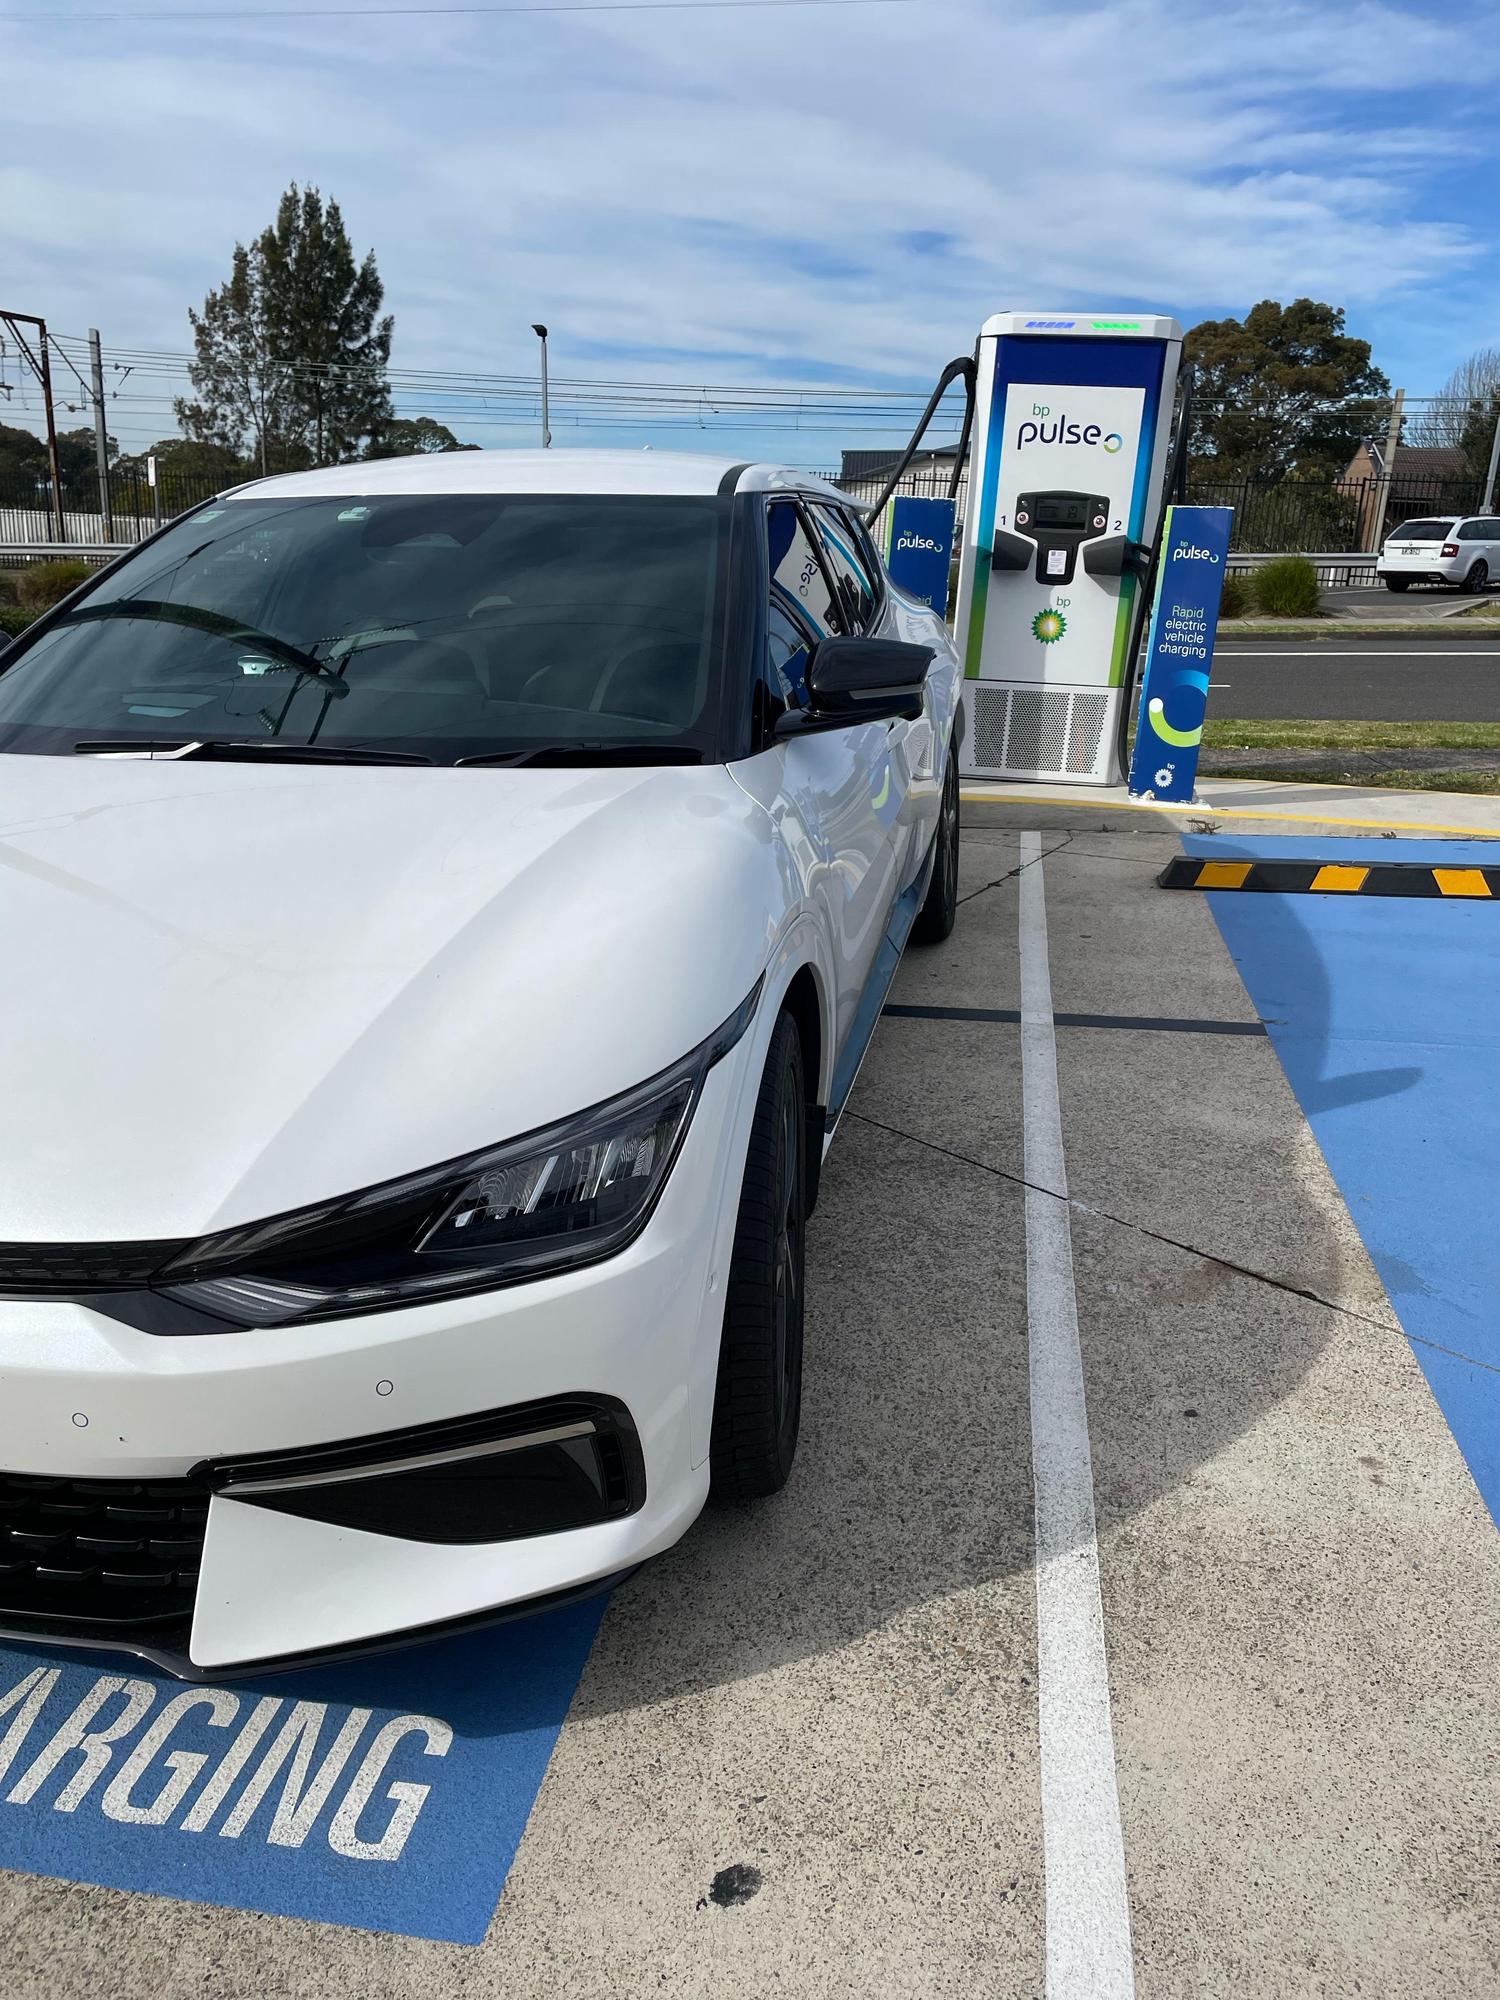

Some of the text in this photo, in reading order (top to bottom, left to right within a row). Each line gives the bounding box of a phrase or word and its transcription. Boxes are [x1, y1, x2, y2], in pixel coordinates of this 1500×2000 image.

[1032, 403, 1050, 419] bp
[1017, 414, 1102, 451] pulse
[1001, 515, 1007, 525] 1
[1114, 520, 1122, 531] 2
[903, 529, 912, 538] bp
[897, 535, 934, 551] pulse
[1180, 540, 1189, 548] bp
[1173, 545, 1210, 562] pulse
[1056, 596, 1071, 608] bp
[1172, 605, 1204, 619] Rapid
[1165, 619, 1207, 631] electric
[1164, 631, 1204, 643] vehicle
[1159, 644, 1206, 659] charging
